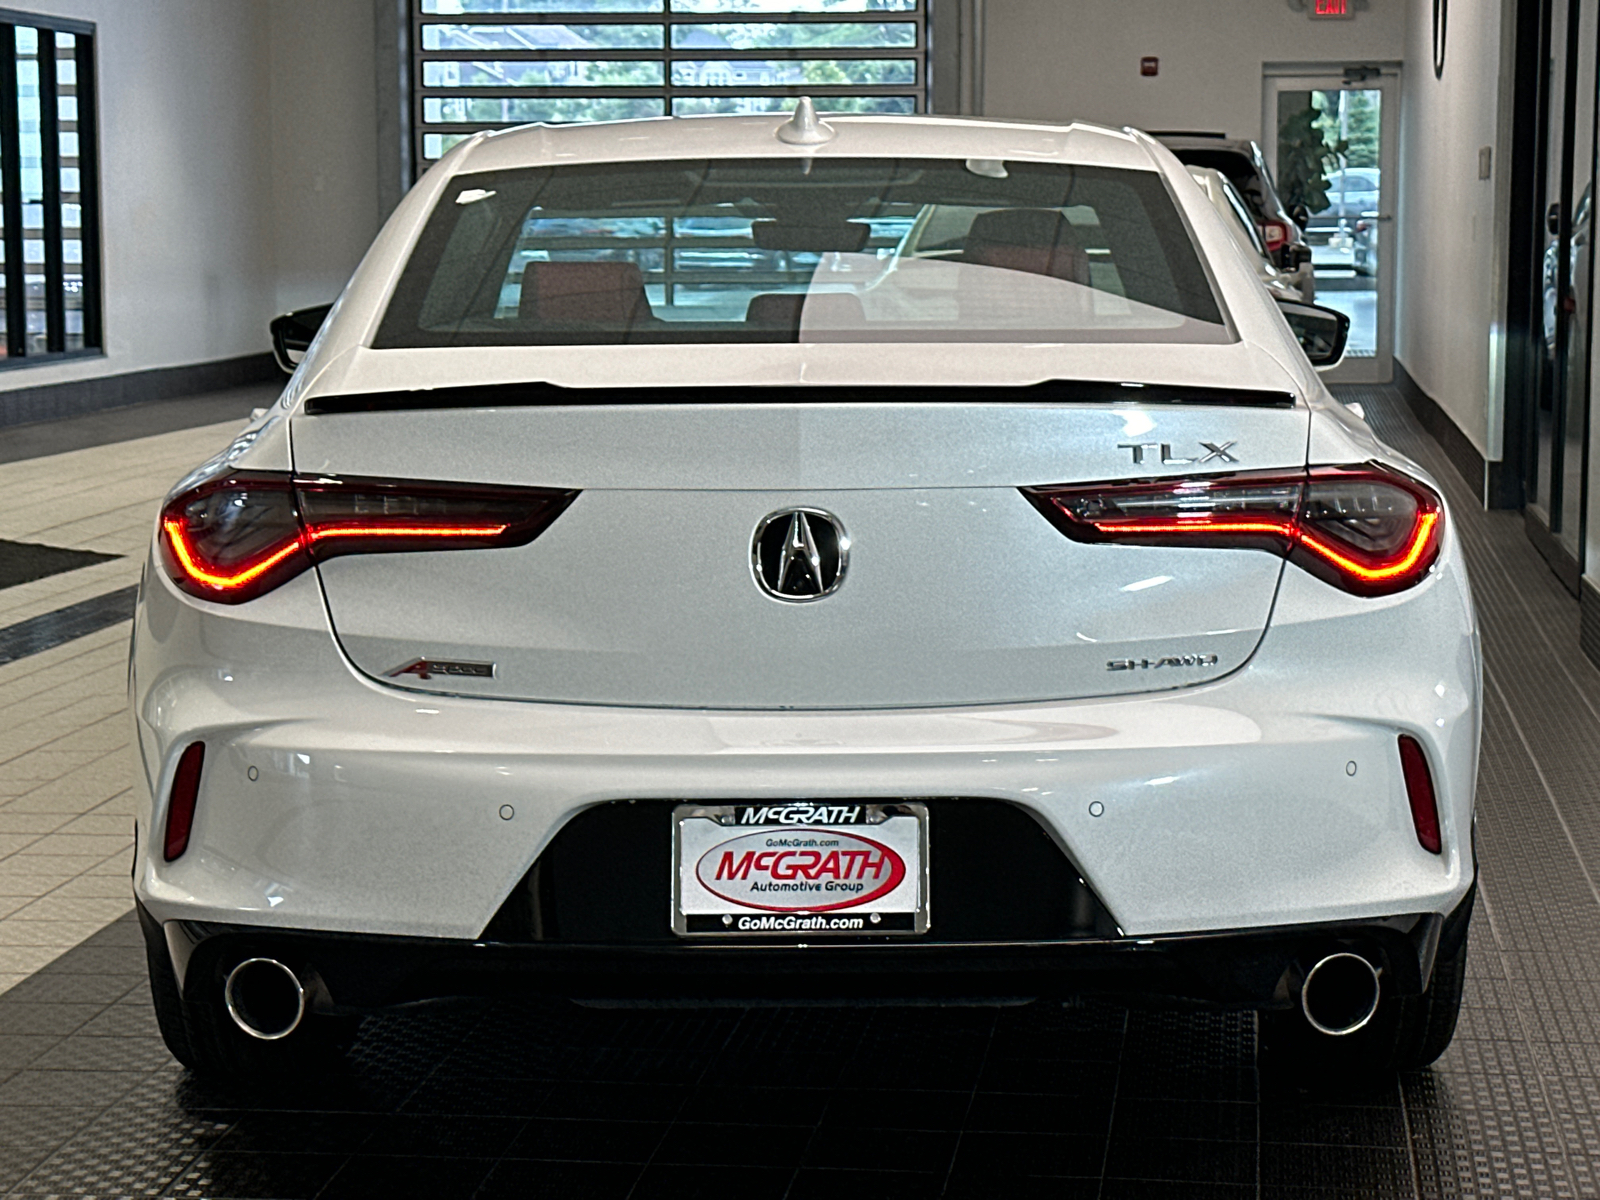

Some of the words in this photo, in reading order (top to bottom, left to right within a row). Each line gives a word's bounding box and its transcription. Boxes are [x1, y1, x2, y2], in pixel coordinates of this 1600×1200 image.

[1117, 441, 1239, 464] TLX
[765, 838, 840, 848] GoMcGrath.com
[750, 881, 822, 892] Automotive
[824, 881, 864, 893] Group
[738, 916, 864, 930] GoMcGrath.com
